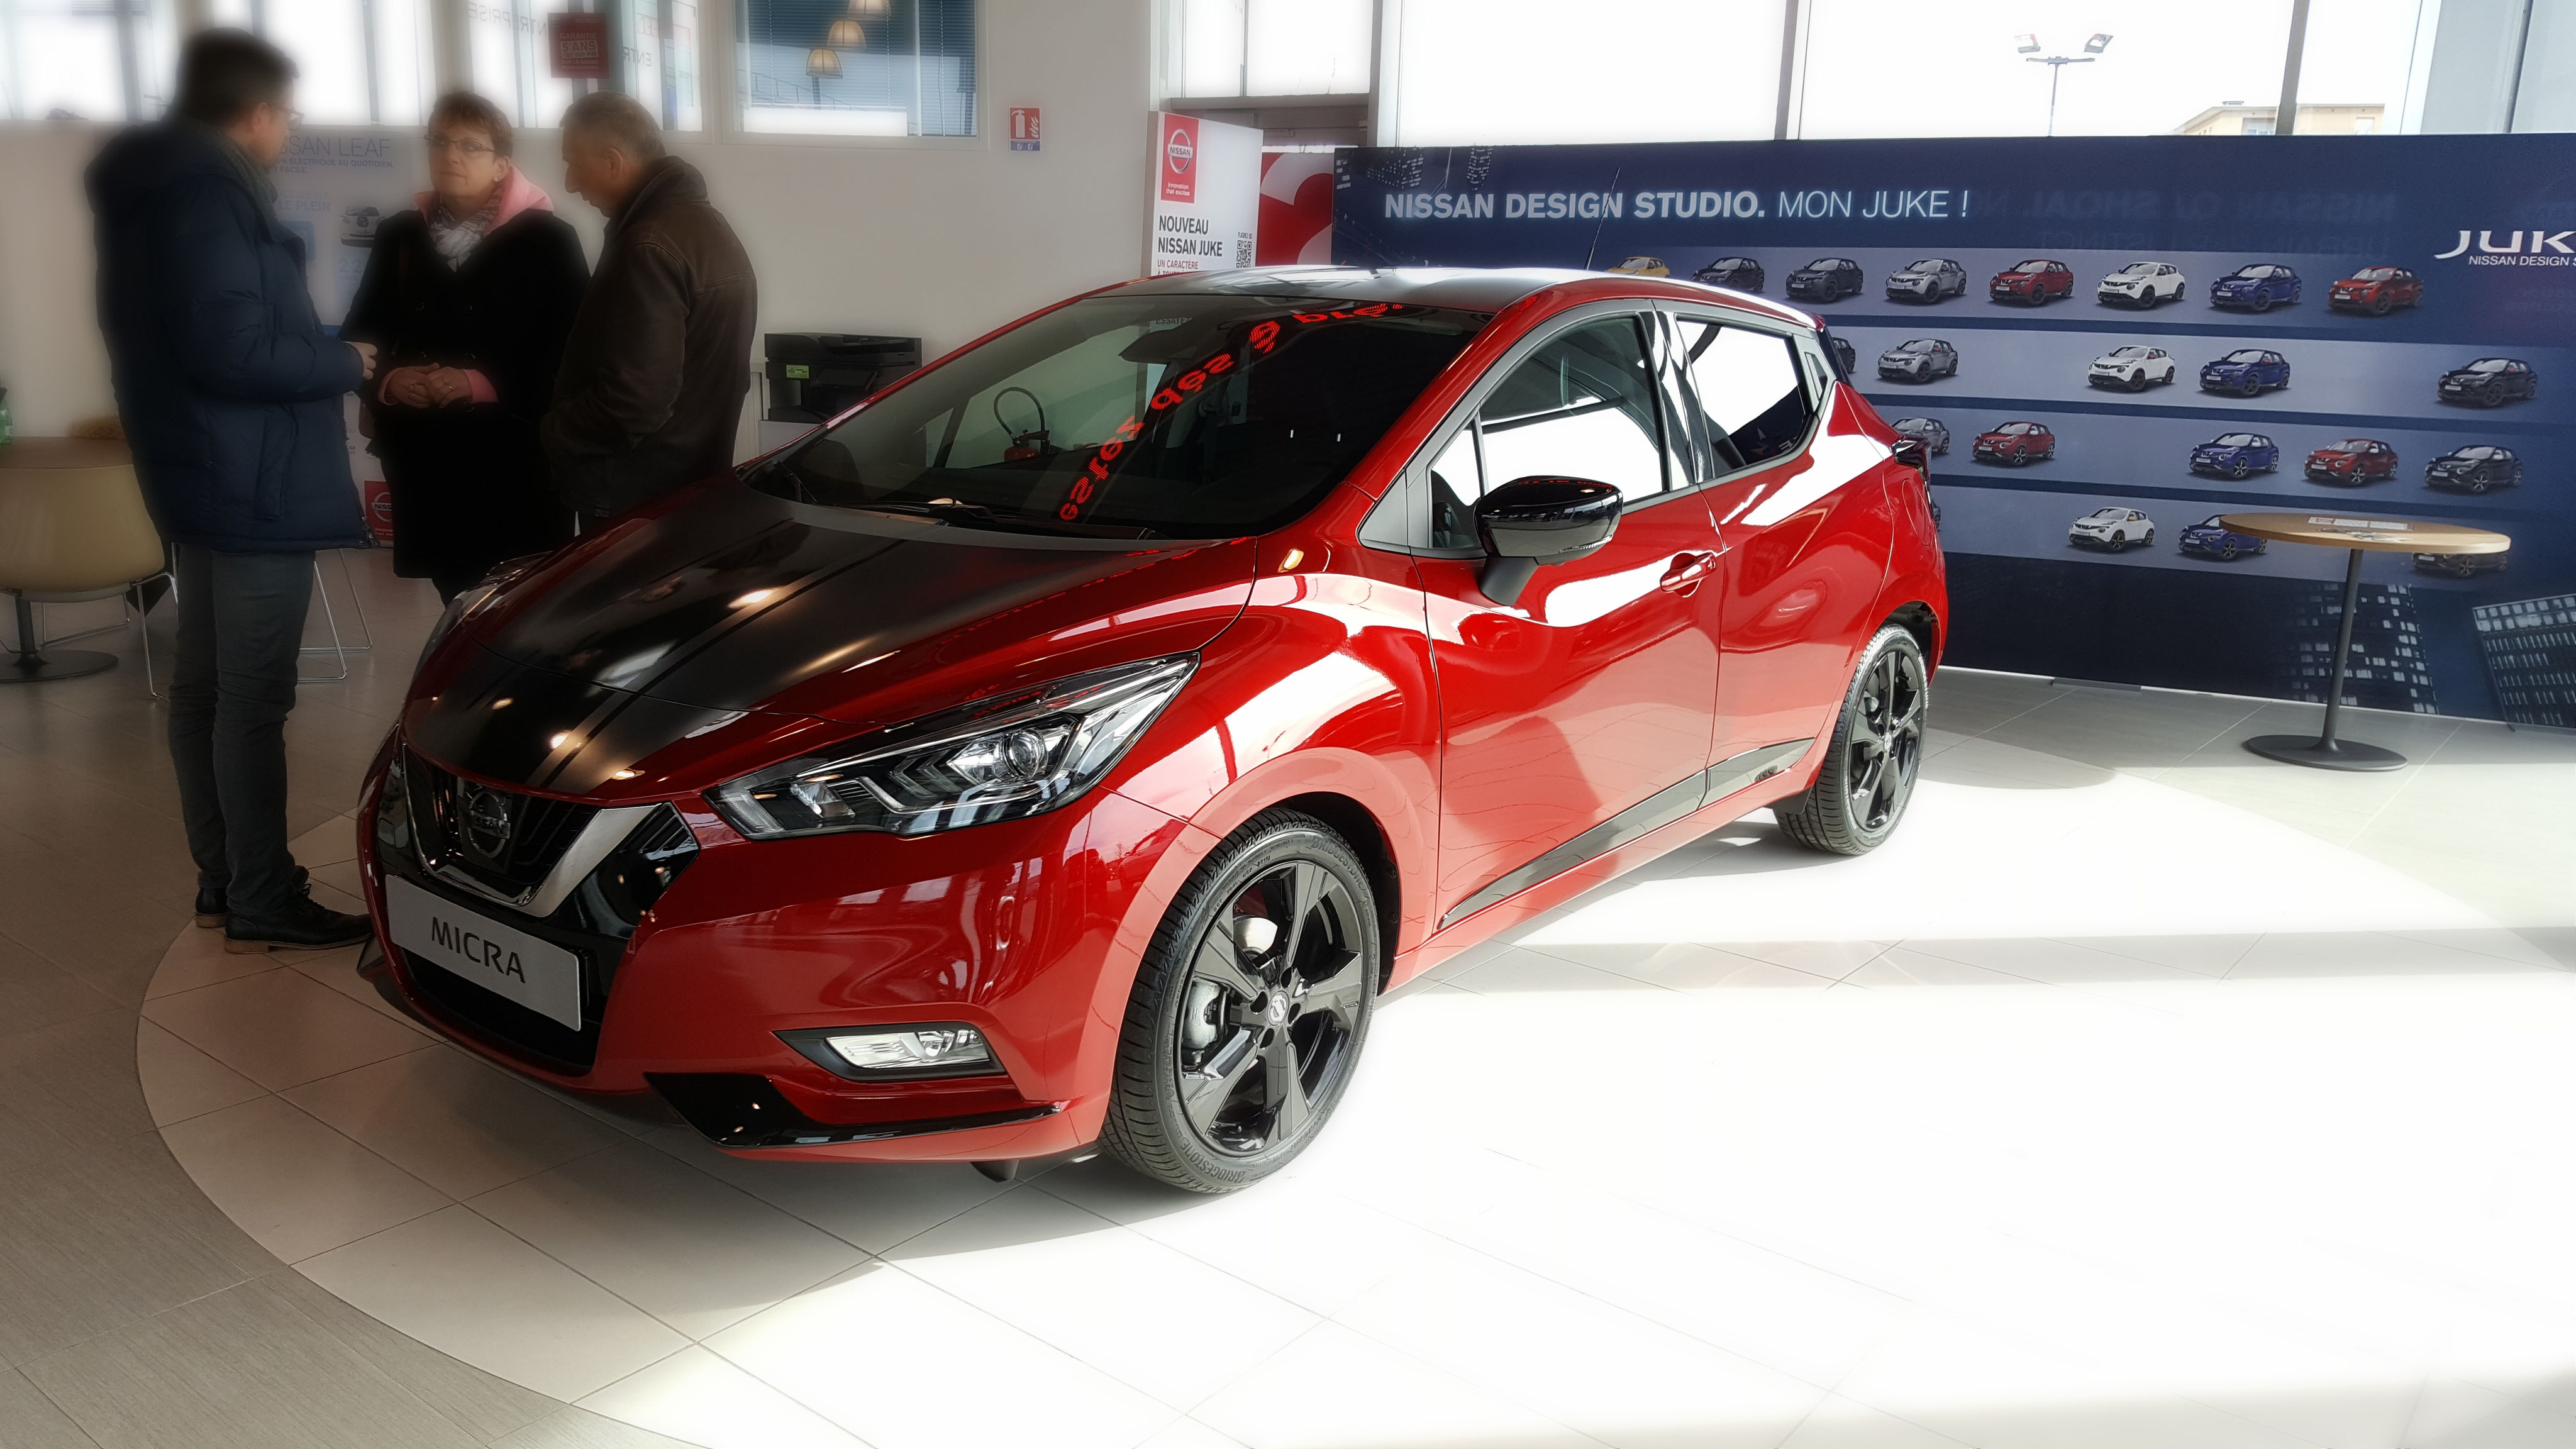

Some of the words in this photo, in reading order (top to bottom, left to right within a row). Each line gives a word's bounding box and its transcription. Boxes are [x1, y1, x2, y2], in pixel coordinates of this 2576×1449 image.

[562, 42, 569, 52] 5
[572, 41, 596, 52] ANS
[338, 136, 391, 157] LEAF
[1169, 146, 1191, 157] NISSAN
[351, 159, 395, 169] QUOTIDIEN,
[1167, 181, 1189, 191] Innovation
[1385, 193, 1494, 219] NISSAN
[1505, 192, 1623, 219] DESIGN
[1634, 191, 1765, 219] STUDIO.
[1778, 191, 1852, 218] MON
[1862, 190, 1950, 218] JUKE
[1961, 190, 1968, 218] !
[1159, 214, 1209, 235] NOUVEAU
[1158, 236, 1196, 256] NISSAN
[1199, 240, 1223, 257] JUKE
[2434, 230, 2576, 260] JUK
[1157, 258, 1165, 268] UN
[1167, 258, 1199, 270] CARACTÈRE
[2468, 255, 2516, 266] NISSAN
[2519, 256, 2570, 267] DESIGN
[431, 916, 526, 984] MICRA
[1180, 1137, 1247, 1184] BRIDGESTONE
